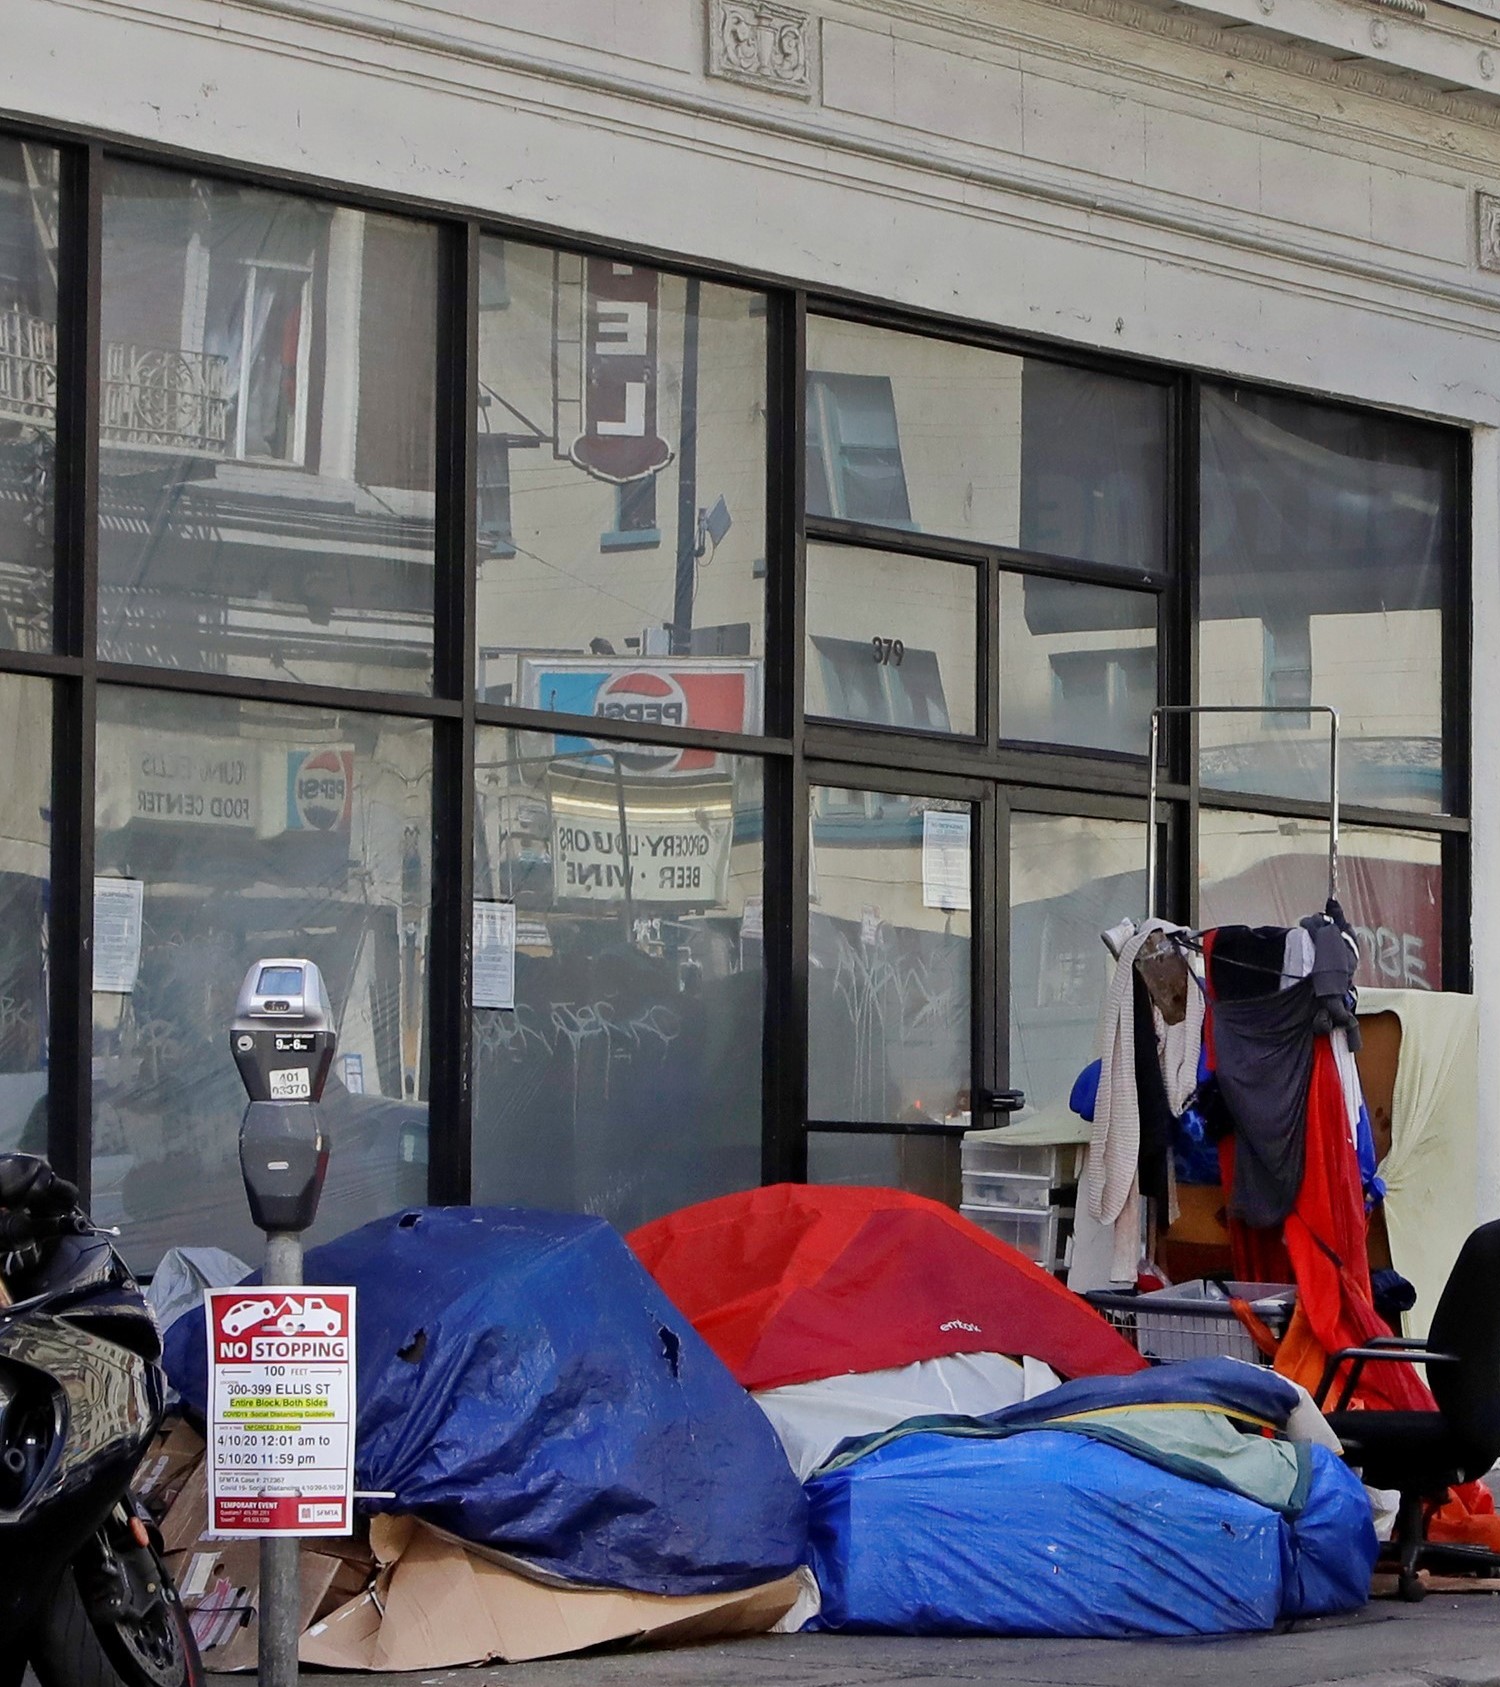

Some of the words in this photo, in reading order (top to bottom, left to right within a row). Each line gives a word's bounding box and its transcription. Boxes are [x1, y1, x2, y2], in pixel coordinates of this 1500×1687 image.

[872, 636, 904, 666] 379
[220, 1342, 248, 1358] NO
[255, 1342, 345, 1358] STOPPING
[264, 1366, 286, 1376] 100
[290, 1368, 308, 1376] FEET
[227, 1384, 272, 1395] 300-399
[276, 1384, 312, 1395] ELLIS
[315, 1384, 331, 1395] ST
[230, 1398, 254, 1408] Entire
[305, 1398, 328, 1408] Sides
[218, 1436, 258, 1446] 4/10/20
[261, 1436, 293, 1446] 12:01
[298, 1437, 315, 1446] am
[319, 1436, 330, 1446] to
[218, 1454, 258, 1464] 5/10/20
[261, 1454, 294, 1464] 11:59
[298, 1455, 316, 1466] pm
[220, 1501, 257, 1509] TEMPORARY
[258, 1501, 278, 1509] EVENT
